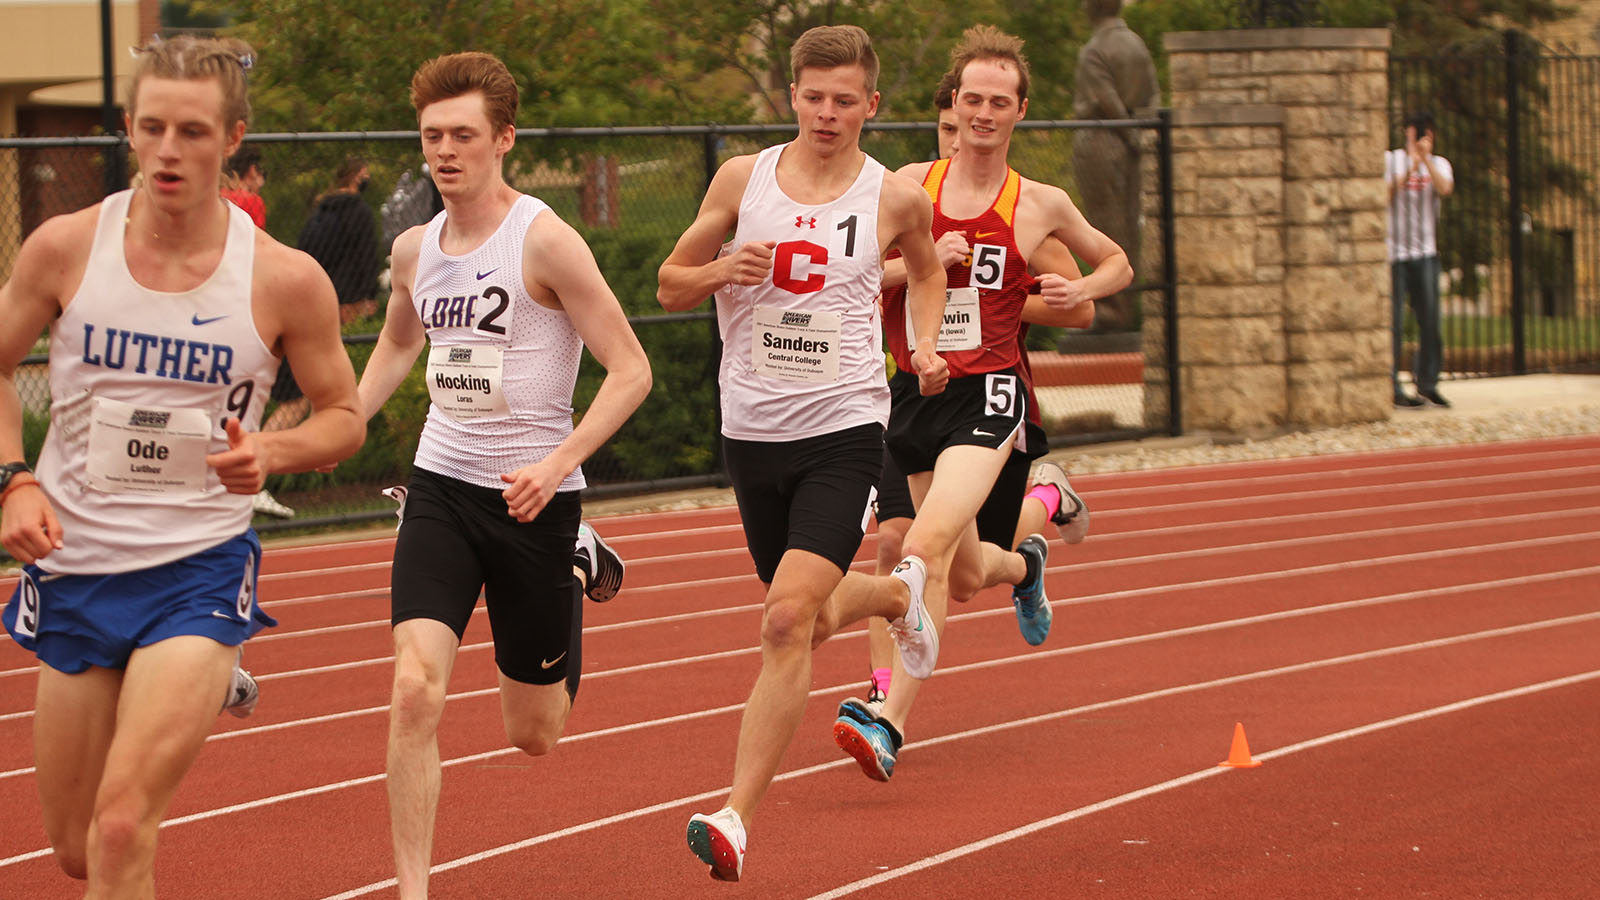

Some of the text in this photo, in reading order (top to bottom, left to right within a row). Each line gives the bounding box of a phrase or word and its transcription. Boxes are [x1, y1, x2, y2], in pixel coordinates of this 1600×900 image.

[836, 214, 857, 257] 1
[773, 240, 828, 294] C
[975, 247, 1000, 285] 5
[421, 295, 478, 329] LORA
[477, 286, 510, 335] 2
[763, 332, 829, 353] Sanders
[945, 327, 966, 335] (Iowa)
[83, 323, 234, 385] LUTHER
[768, 352, 822, 366] Central College
[436, 372, 491, 394] Hocking
[457, 395, 473, 403] Loras
[990, 377, 1011, 414] 5
[221, 379, 254, 430] 9
[127, 439, 169, 460] Ode
[130, 464, 162, 474] Luther
[23, 575, 36, 632] 9
